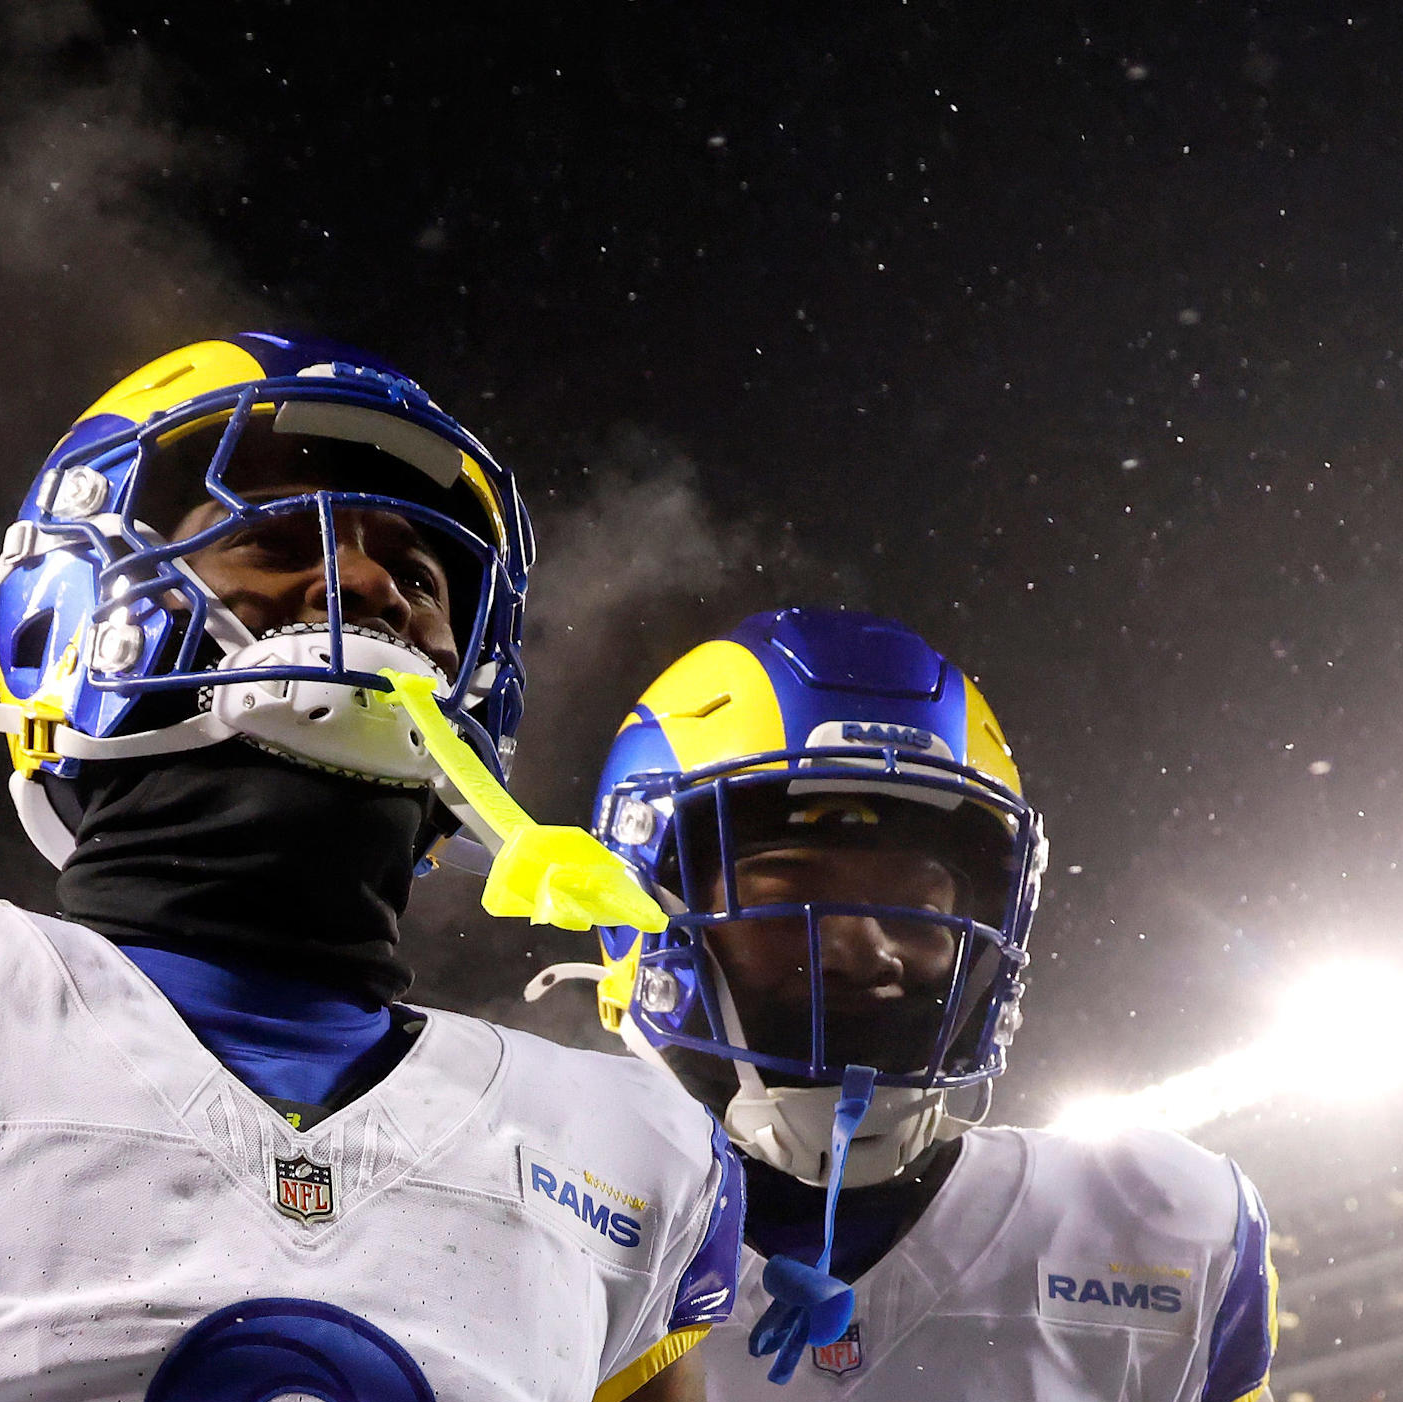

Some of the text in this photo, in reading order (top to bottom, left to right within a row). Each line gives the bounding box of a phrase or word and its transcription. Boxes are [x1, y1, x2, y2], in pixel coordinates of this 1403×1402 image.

[841, 722, 933, 750] RAMS
[281, 1180, 328, 1211] NFL
[530, 1162, 642, 1248] RAMS
[1047, 1273, 1182, 1314] RAMS
[819, 1342, 858, 1368] NFL
